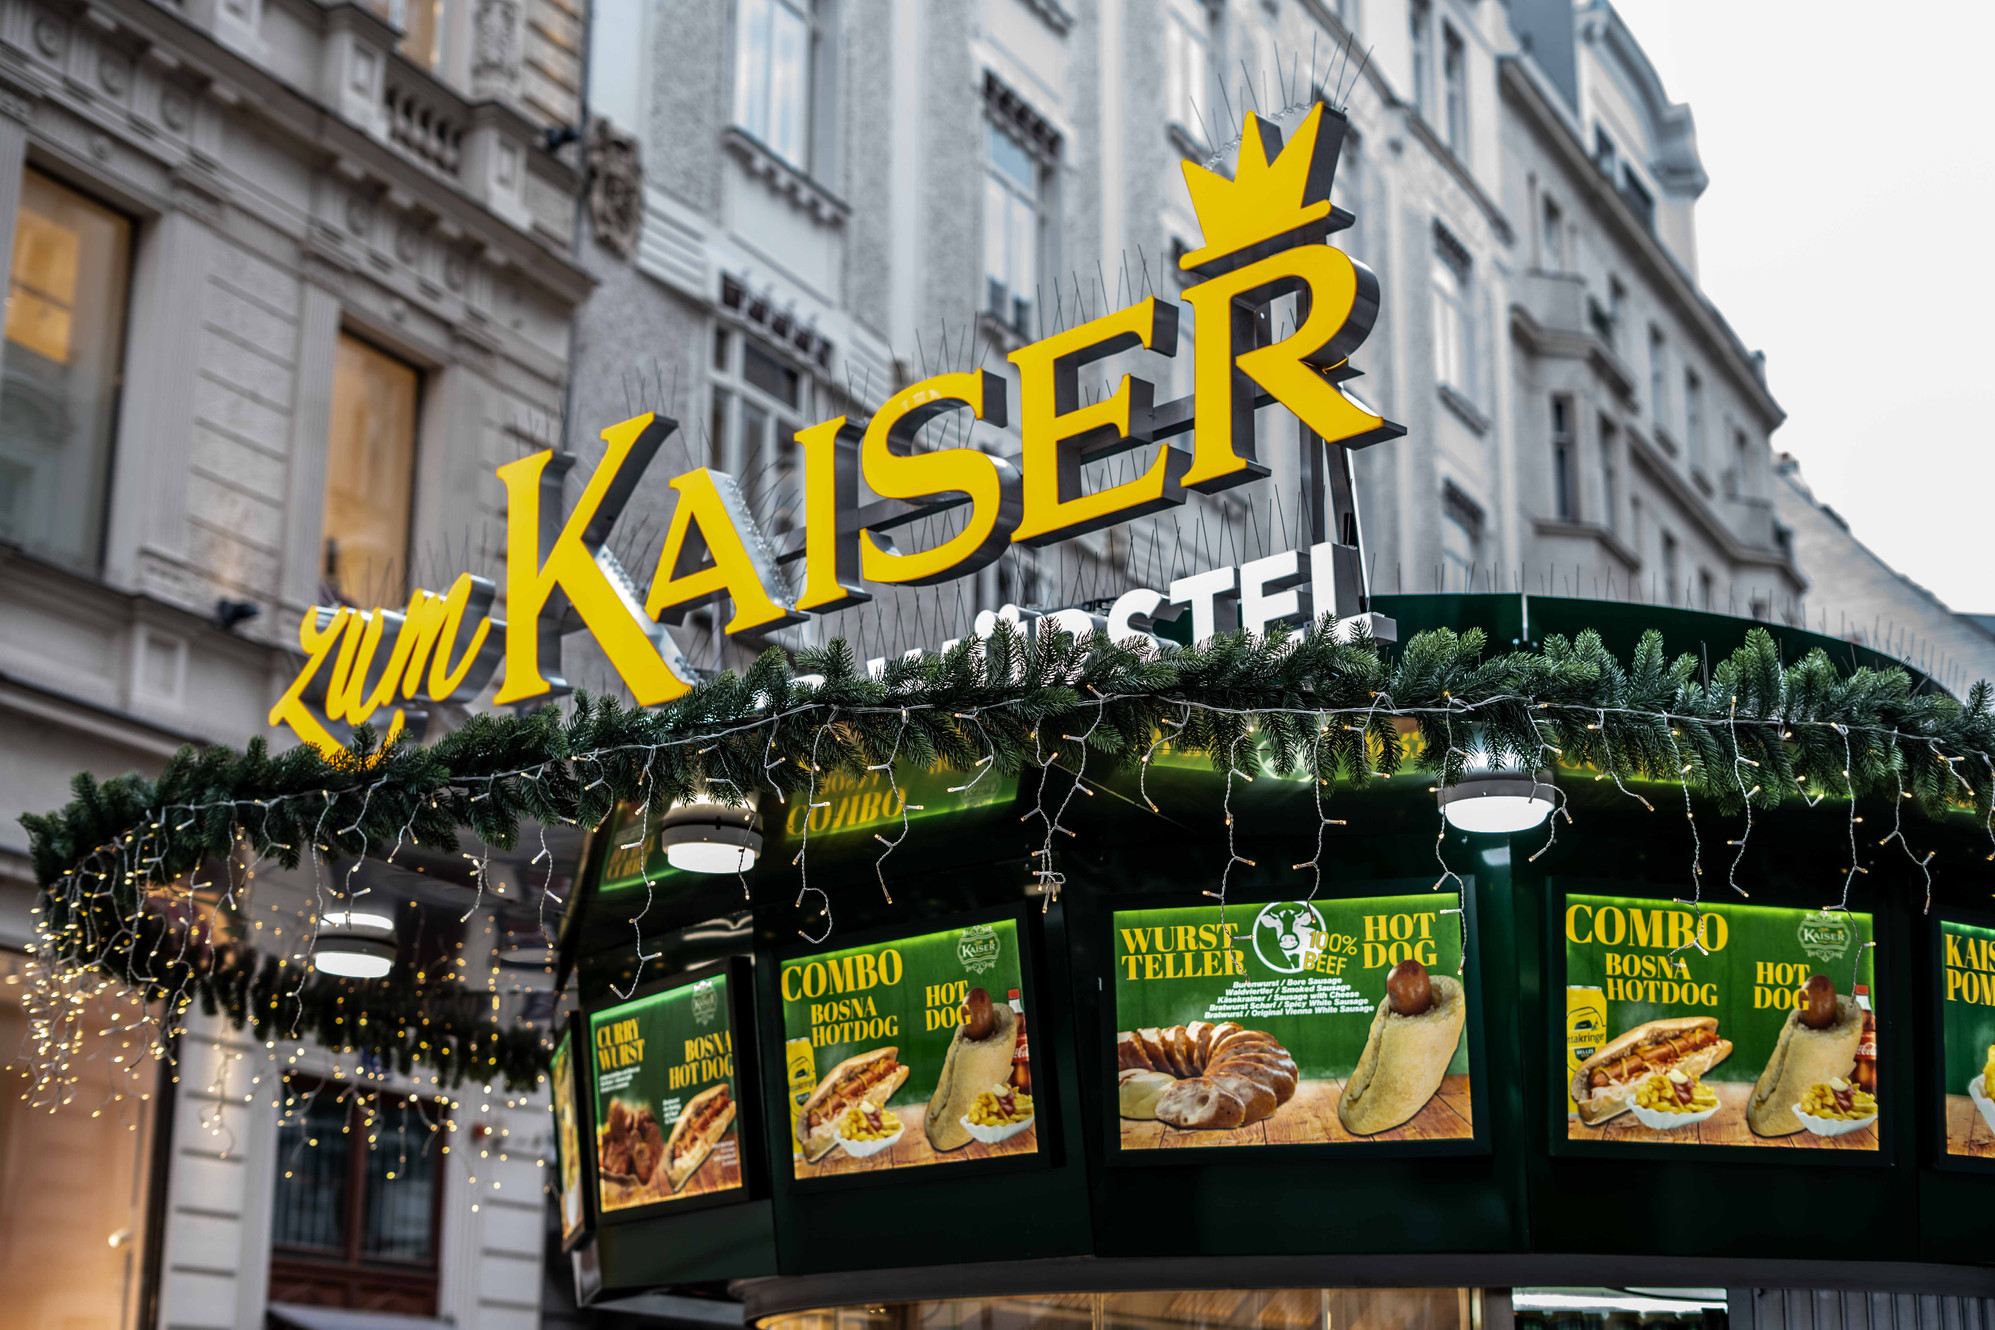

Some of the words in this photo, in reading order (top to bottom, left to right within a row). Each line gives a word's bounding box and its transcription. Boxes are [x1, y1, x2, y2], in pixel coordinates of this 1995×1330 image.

[493, 244, 1381, 706] KAISER
[1120, 923, 1240, 955] WURST
[1362, 912, 1437, 942] HOT
[1565, 904, 1729, 952] COMBO
[1307, 930, 1358, 956] 100%
[1362, 939, 1438, 970] DOG
[781, 948, 903, 1002] COMBO
[1121, 949, 1247, 981] TELLER
[1303, 951, 1348, 977] BEEF
[1605, 953, 1692, 980] BOSNA
[1756, 961, 1810, 987] HOT
[925, 980, 969, 1008] HOT
[1281, 985, 1315, 993] Smoked
[1316, 984, 1351, 992] Sausage
[1287, 978, 1306, 986] Bore
[1308, 977, 1342, 985] Sausage
[1606, 978, 1718, 1007] HOTDOG
[810, 995, 878, 1026] BOSNA
[1209, 1003, 1248, 1011] Bratwurst
[1284, 1000, 1307, 1008] Spicy
[1309, 999, 1332, 1007] White
[1274, 993, 1308, 1001] Sausage
[1753, 985, 1810, 1011] DOG
[925, 1003, 972, 1031] DOG
[1204, 1010, 1243, 1019] Bratwurst
[1251, 1008, 1283, 1018] Original
[1285, 1007, 1313, 1015] Vienna
[1315, 1006, 1338, 1014] White
[1340, 1005, 1374, 1013] Sausage
[597, 1016, 640, 1049] CURRY
[684, 1029, 732, 1063] BOSNA
[812, 1015, 899, 1048] HOTDOG
[597, 1038, 645, 1071] WURST
[669, 1061, 700, 1091] HOT
[701, 1053, 734, 1083] DOG
